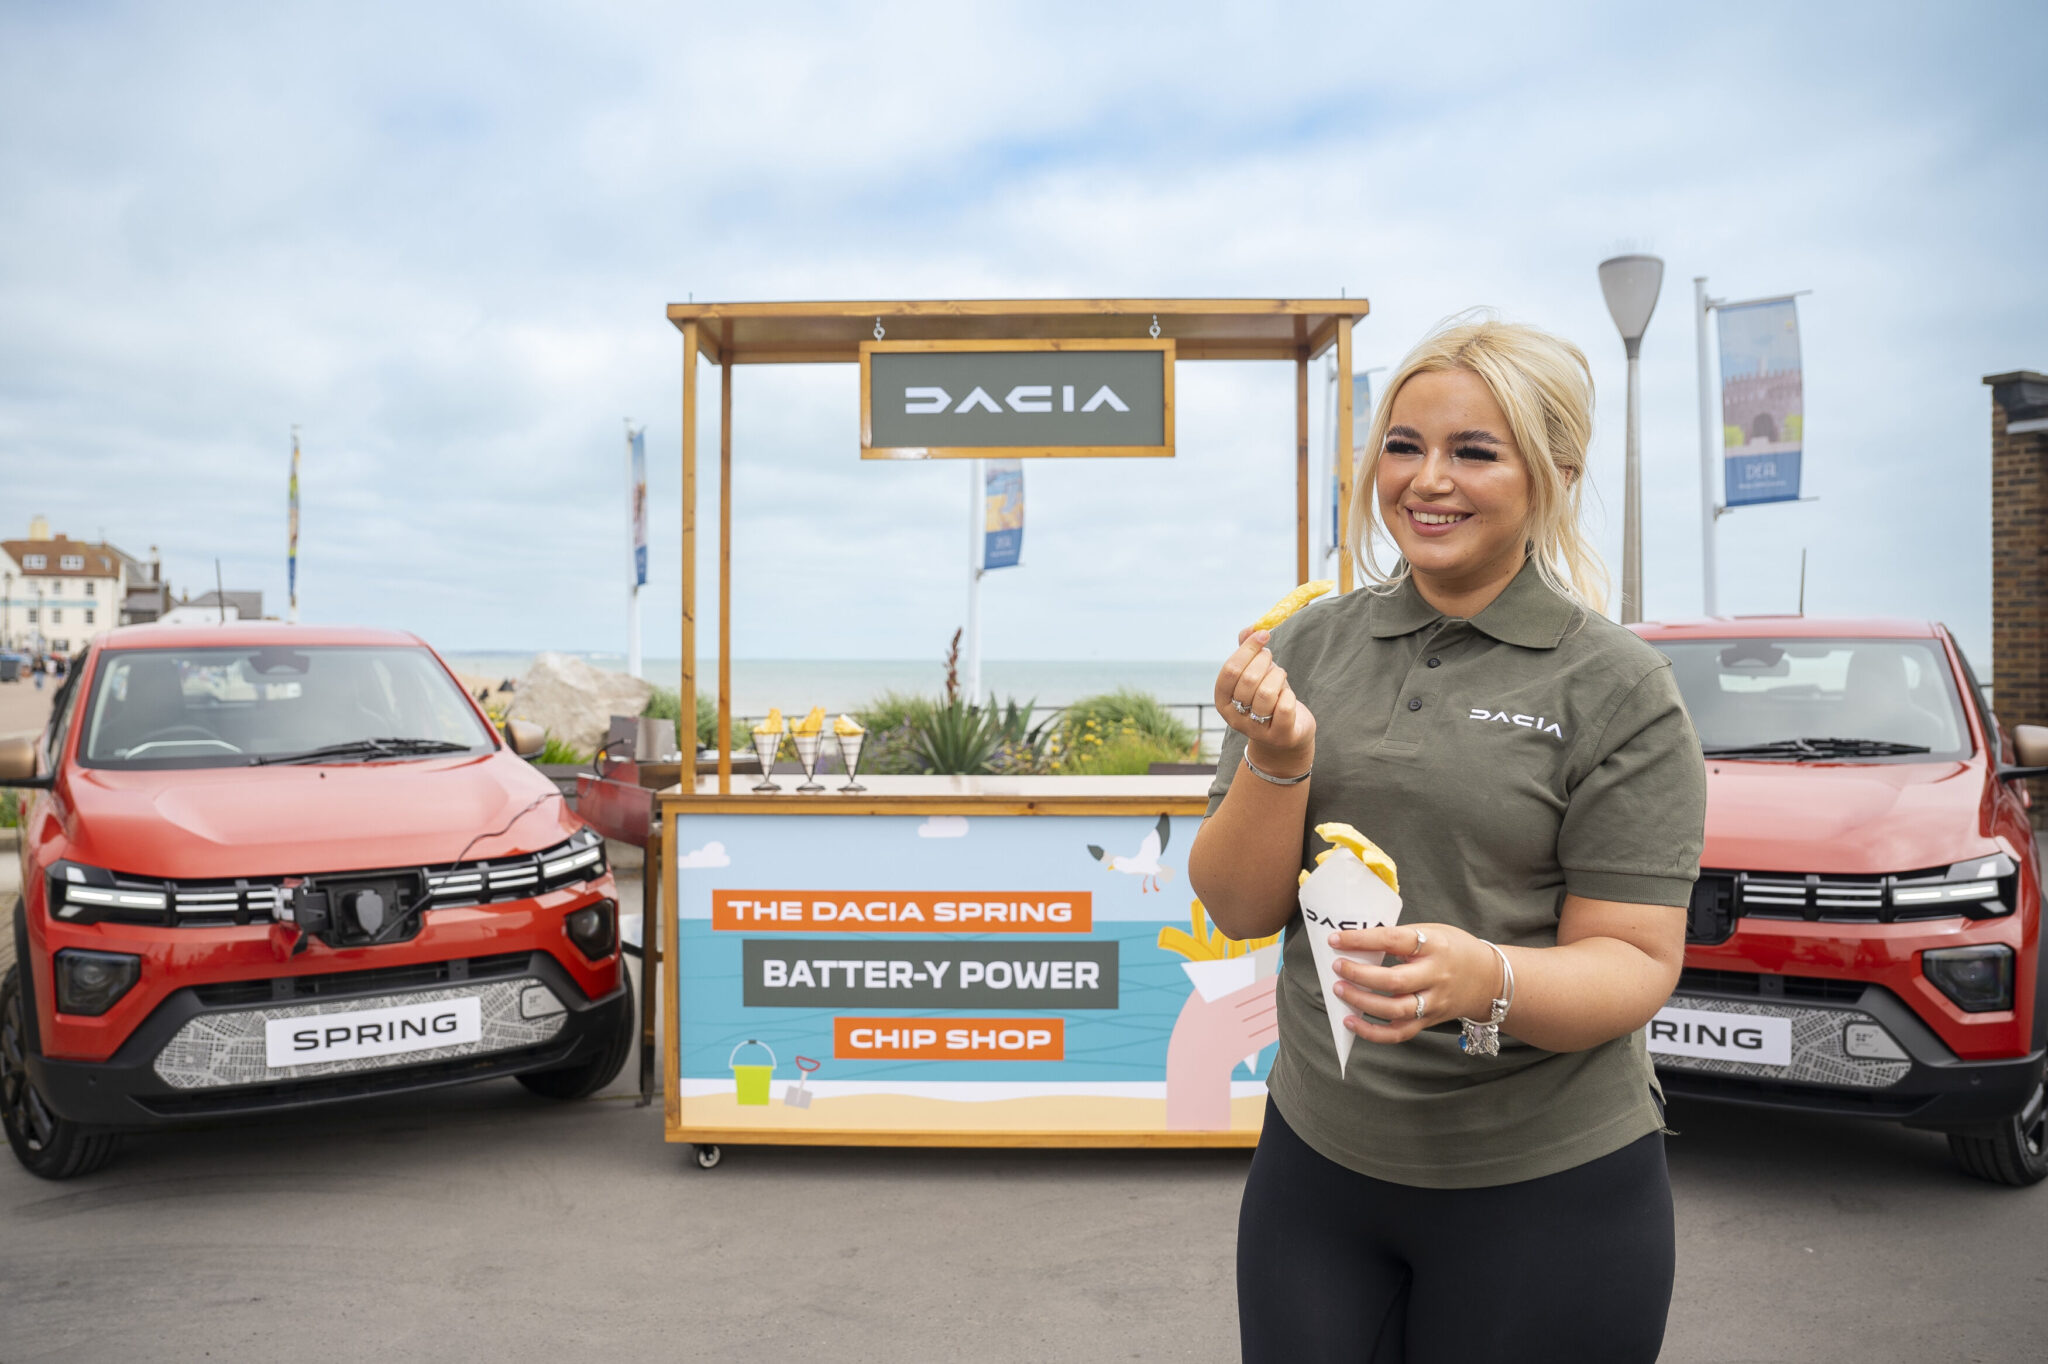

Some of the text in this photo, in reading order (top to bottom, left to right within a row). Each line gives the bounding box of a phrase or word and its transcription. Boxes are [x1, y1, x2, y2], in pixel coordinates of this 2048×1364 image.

[905, 385, 1130, 413] DACIA
[1469, 708, 1563, 739] DACIA
[727, 900, 1073, 923] THE DACIA SPRING
[763, 959, 1100, 990] BATTER-Y POWER
[293, 1012, 458, 1051] SPRING
[849, 1028, 1052, 1050] CHIP SHOP
[1651, 1019, 1763, 1050] RING
